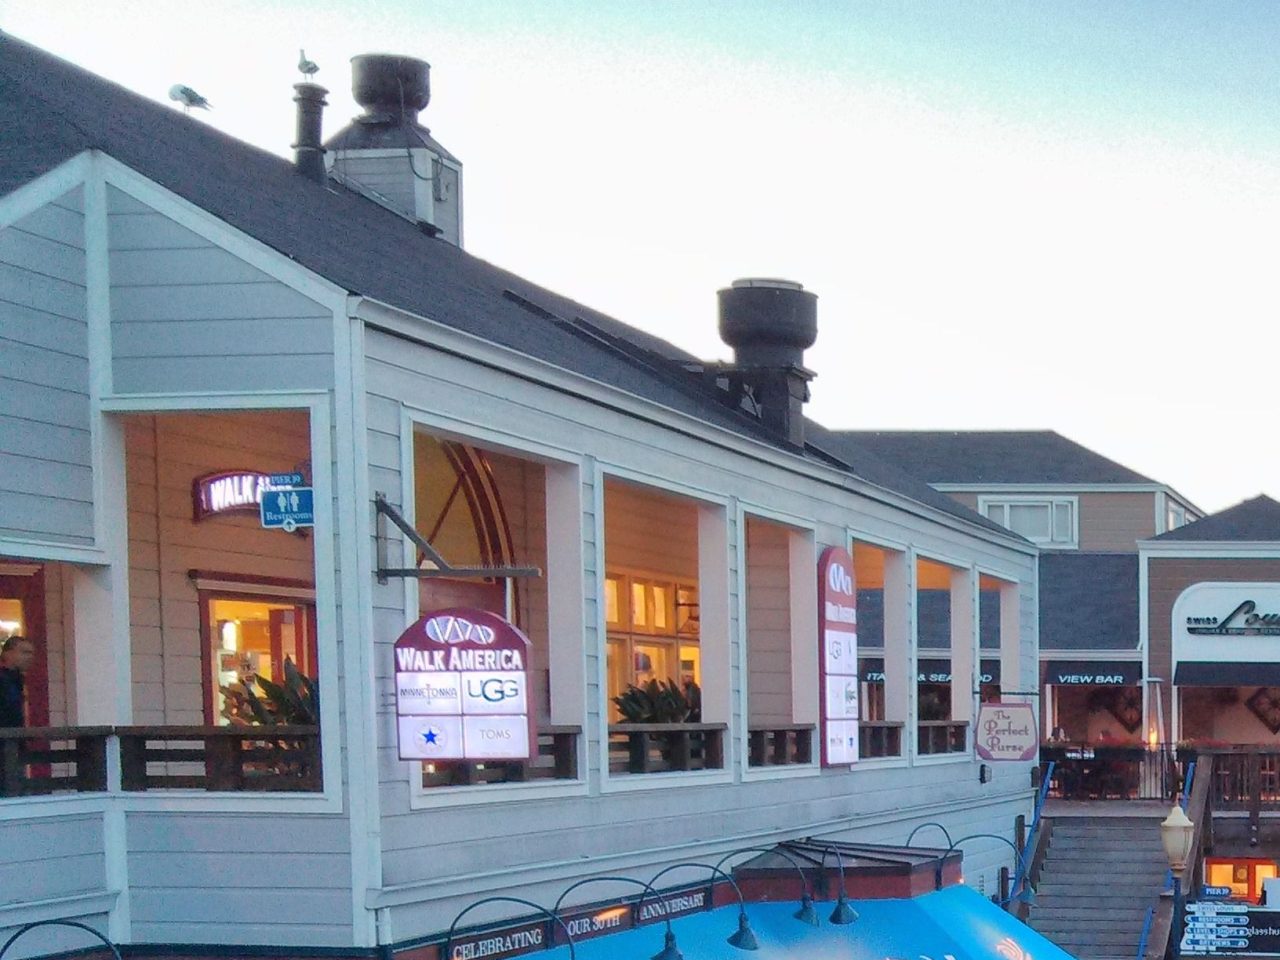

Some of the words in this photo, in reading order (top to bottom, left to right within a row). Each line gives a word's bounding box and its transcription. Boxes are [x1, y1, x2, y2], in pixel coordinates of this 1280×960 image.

[211, 475, 255, 512] WALK
[1186, 616, 1218, 625] SWISS
[396, 647, 446, 671] WALK
[449, 647, 523, 671] AMERICA
[1058, 674, 1092, 684] VIEW
[1095, 675, 1124, 684] BAR
[468, 678, 519, 703] UGG
[993, 710, 1010, 720] The
[480, 729, 511, 740] TOMS
[984, 719, 1030, 737] Perfect
[986, 735, 1024, 752] Purse
[568, 918, 592, 937] OUR
